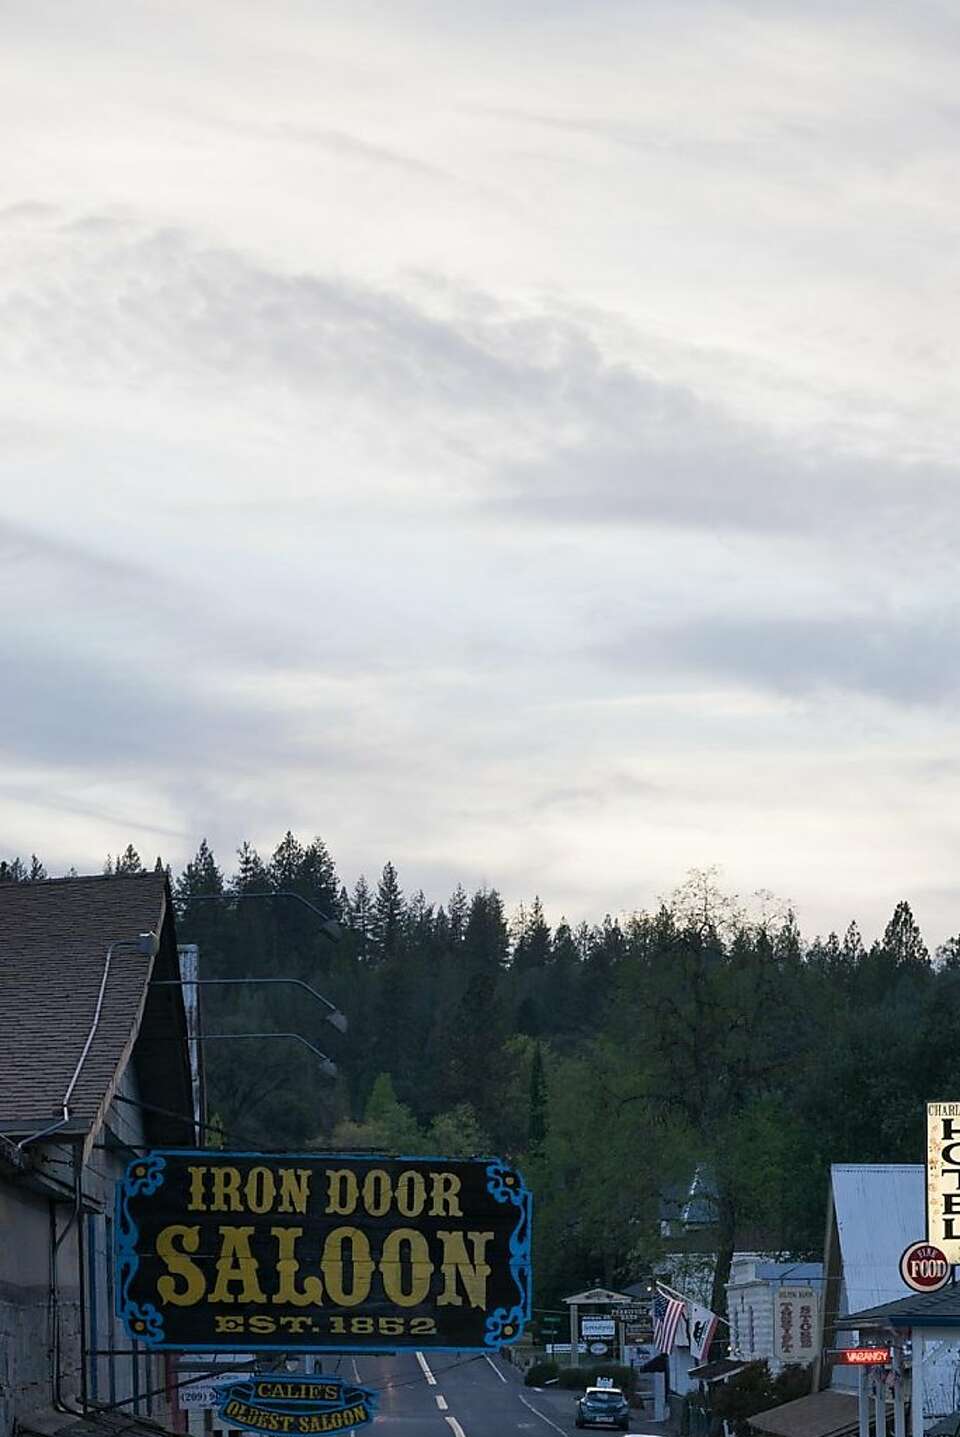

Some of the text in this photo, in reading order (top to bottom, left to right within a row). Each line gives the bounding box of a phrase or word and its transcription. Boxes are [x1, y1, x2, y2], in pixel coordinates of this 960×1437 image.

[187, 1166, 463, 1218] IRON DOOR
[156, 1224, 495, 1311] SALOON
[911, 1259, 947, 1279] FOOD
[330, 1316, 437, 1336] 1852
[846, 1351, 888, 1362] VACANCY
[226, 1401, 368, 1433] OLDEST SALOON
